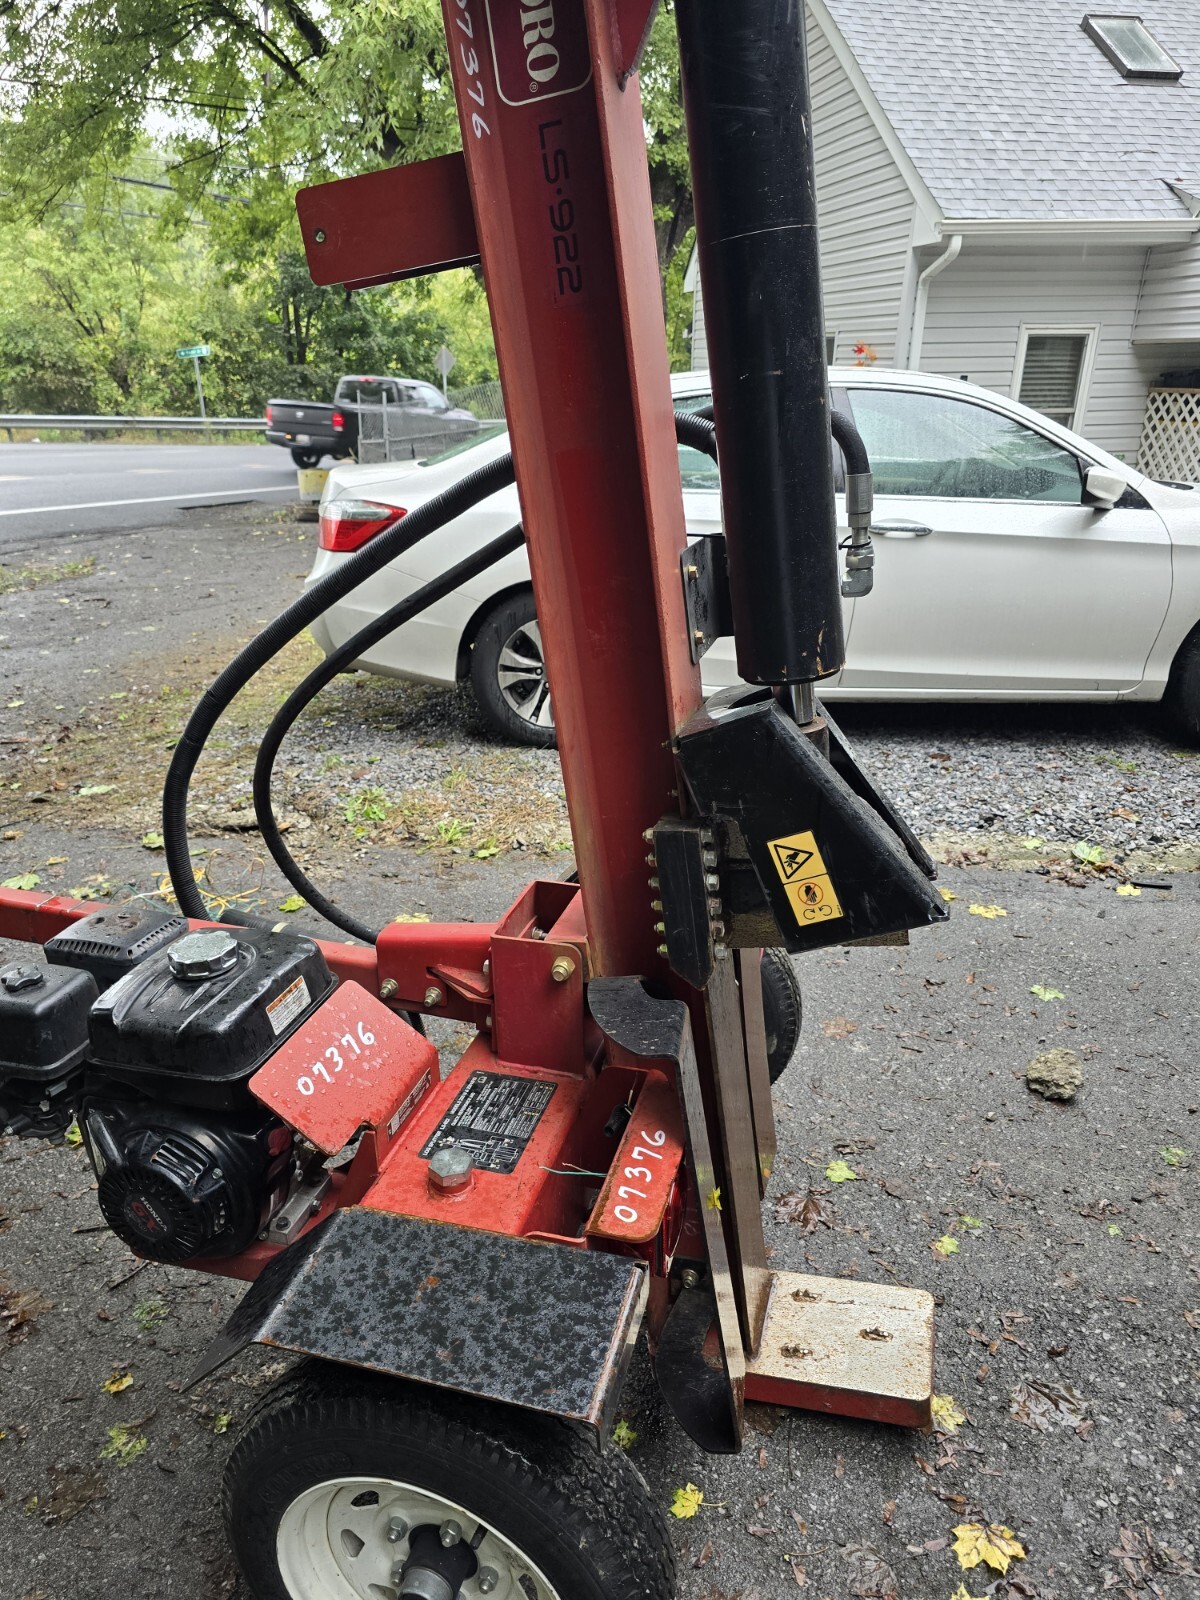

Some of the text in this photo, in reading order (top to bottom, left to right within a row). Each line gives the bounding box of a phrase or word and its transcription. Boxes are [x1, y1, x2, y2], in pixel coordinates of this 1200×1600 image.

[296, 1021, 375, 1096] 07376
[613, 1128, 667, 1223] 07376
[140, 1196, 168, 1232] HONDA
